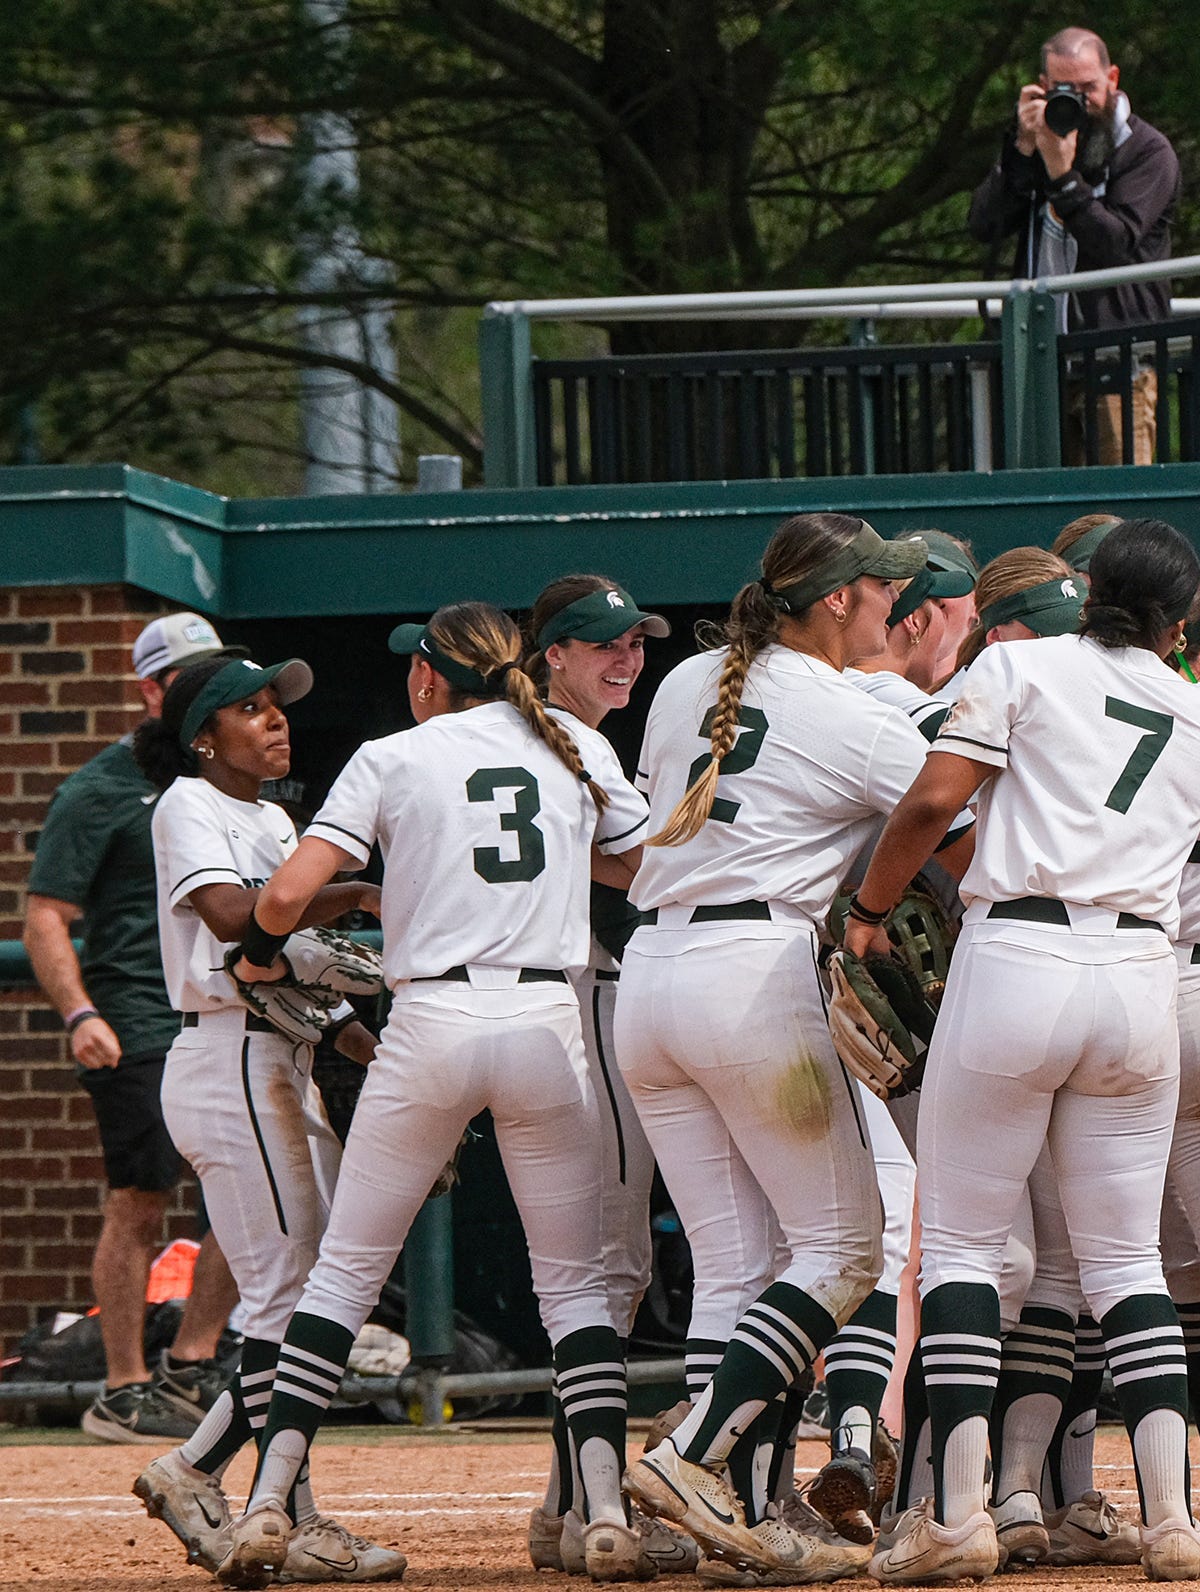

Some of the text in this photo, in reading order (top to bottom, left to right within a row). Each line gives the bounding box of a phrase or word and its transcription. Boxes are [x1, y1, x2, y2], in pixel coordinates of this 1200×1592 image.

[685, 704, 770, 825] 2
[1105, 695, 1174, 815] 7
[465, 766, 546, 884] 3
